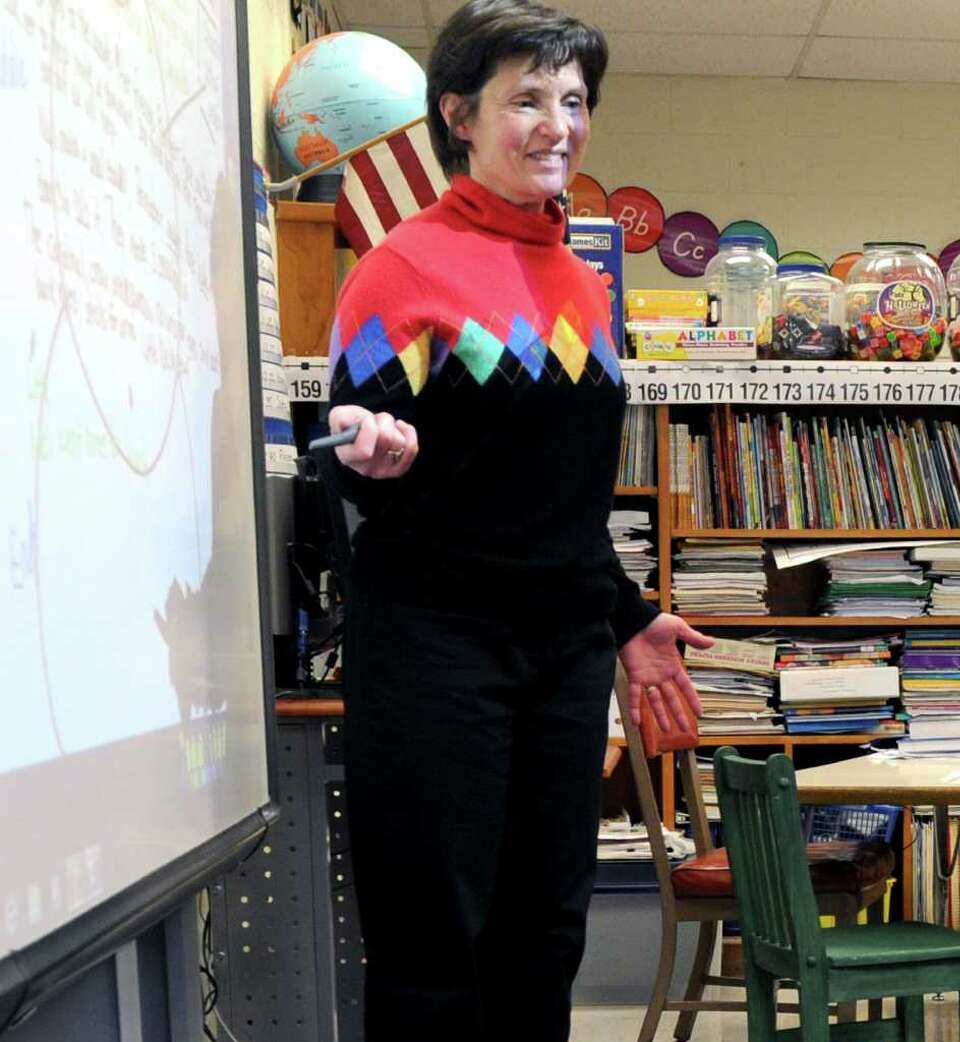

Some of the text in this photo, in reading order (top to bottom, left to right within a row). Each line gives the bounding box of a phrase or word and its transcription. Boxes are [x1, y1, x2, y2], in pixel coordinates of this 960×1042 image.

[616, 205, 649, 236] Bb
[673, 231, 704, 260] Cc
[677, 330, 753, 341] ALPHABET
[290, 380, 321, 398] 159
[639, 382, 667, 402] 169
[672, 382, 701, 402] 170
[706, 382, 734, 402] 171
[740, 382, 768, 402] 172
[773, 383, 802, 402] 173
[807, 383, 835, 402] 174
[841, 383, 869, 402] 175
[874, 383, 902, 402] 176
[906, 383, 934, 402] 177
